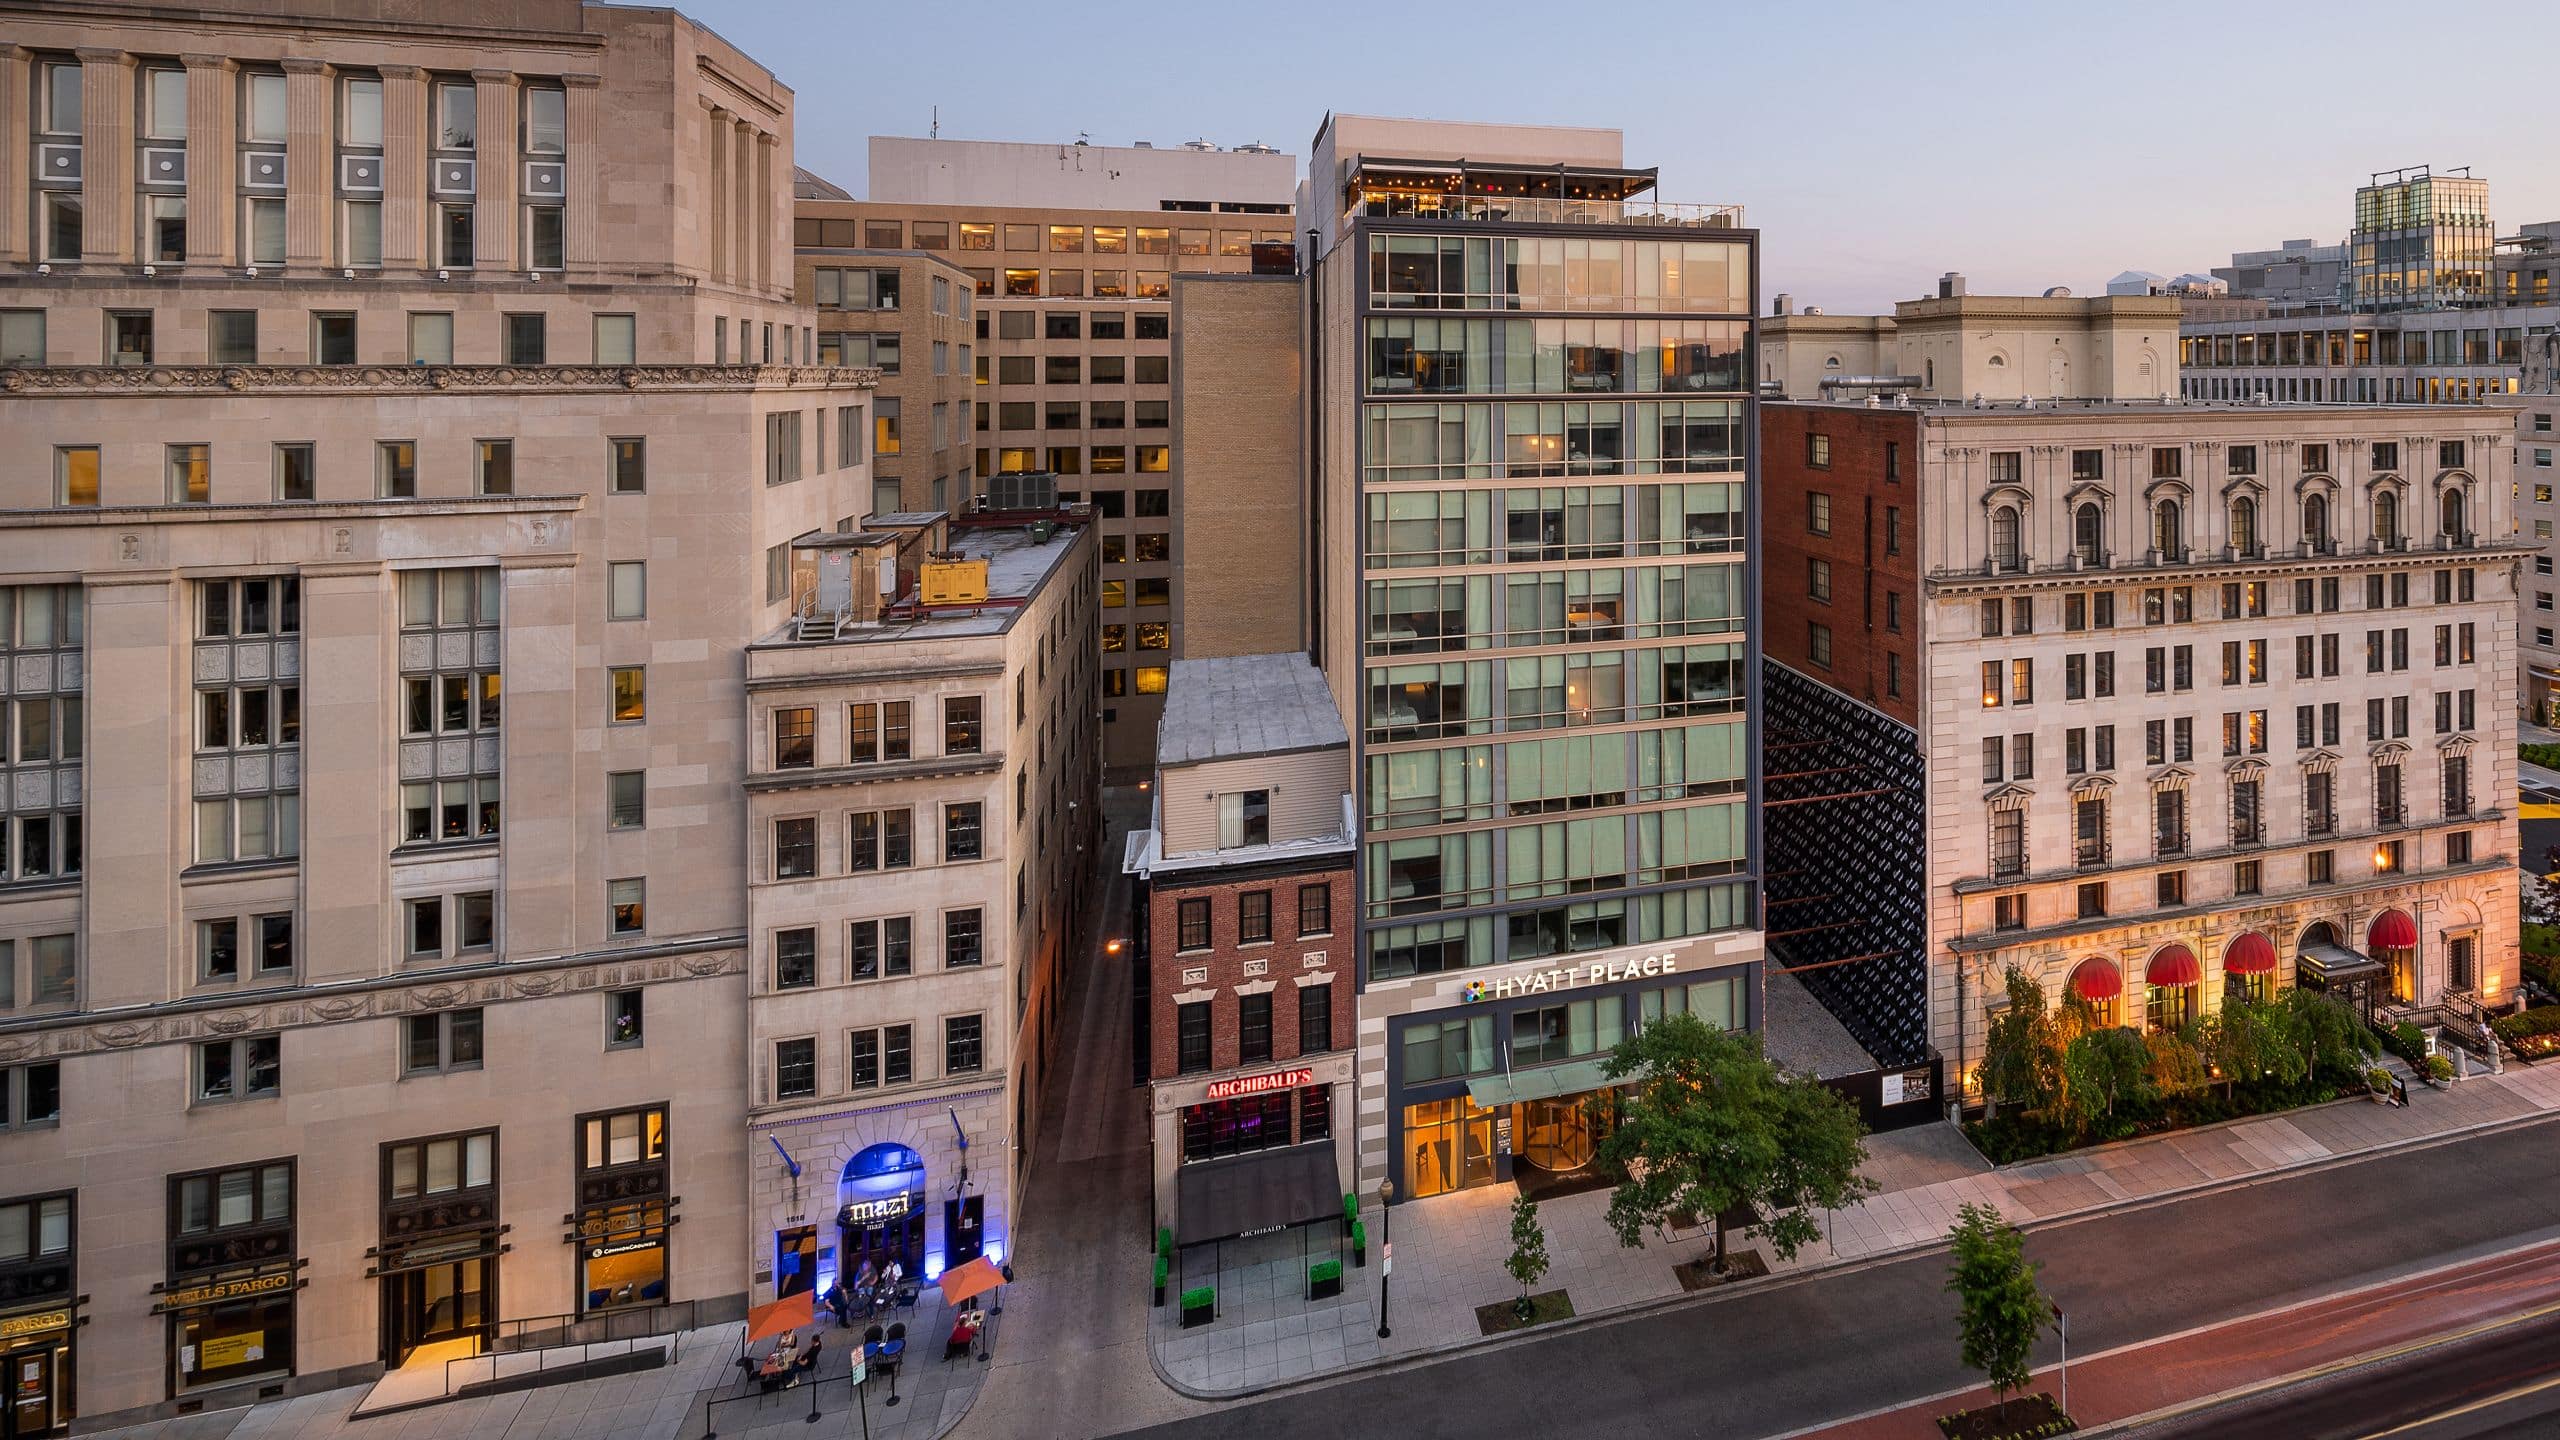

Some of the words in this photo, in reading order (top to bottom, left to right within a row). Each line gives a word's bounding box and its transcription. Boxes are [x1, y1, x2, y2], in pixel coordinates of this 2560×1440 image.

[1495, 967, 1579, 999] HYATT
[1590, 953, 1676, 984] PLACE
[1208, 1069, 1313, 1098] ARCHIBALD'S
[850, 1191, 909, 1221] mazi
[165, 1286, 226, 1306] WELLS
[229, 1275, 288, 1296] FARGO
[2, 1313, 66, 1335] FARGO
